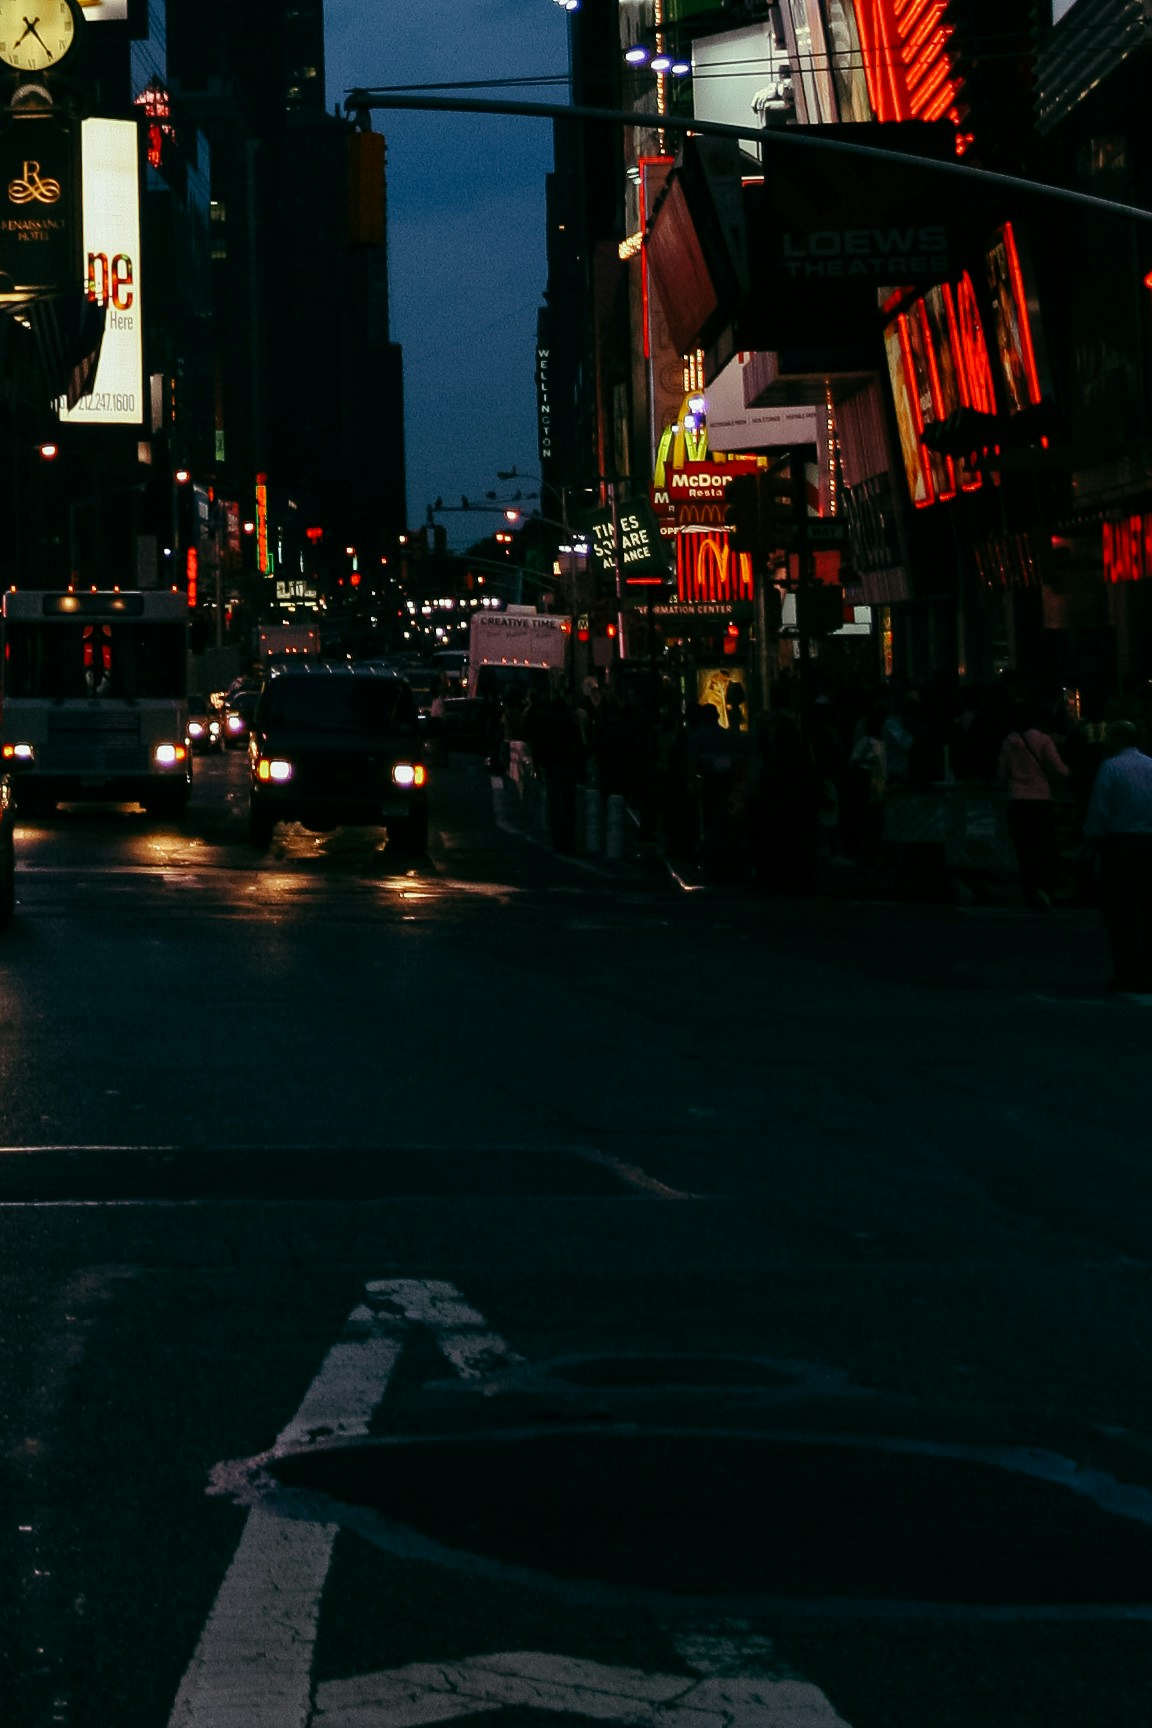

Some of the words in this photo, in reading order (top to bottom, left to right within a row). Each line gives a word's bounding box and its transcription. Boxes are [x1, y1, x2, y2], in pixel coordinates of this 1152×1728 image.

[782, 225, 949, 256] LOEWS
[784, 258, 949, 277] THEATRES
[110, 311, 134, 330] Here
[537, 349, 552, 458] WELLINGTON
[480, 617, 529, 629] CREATIVE
[532, 619, 557, 630] TIME
